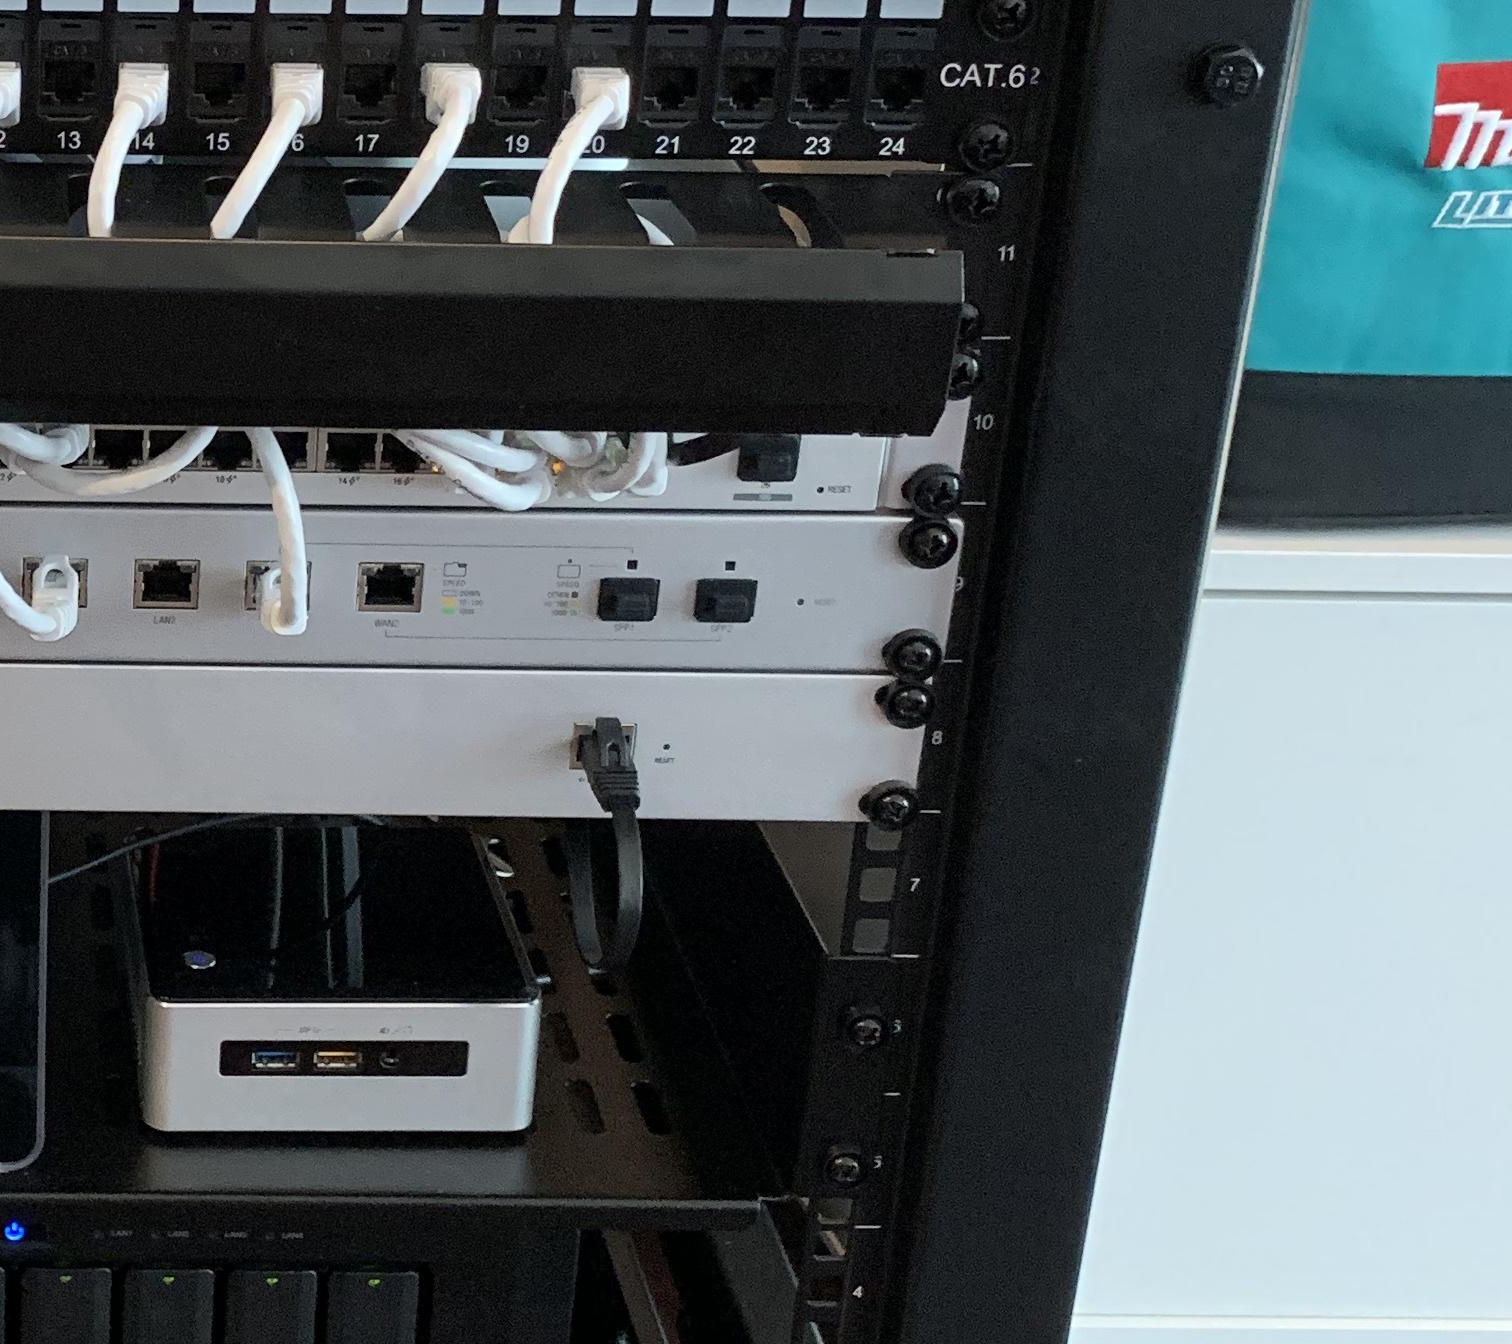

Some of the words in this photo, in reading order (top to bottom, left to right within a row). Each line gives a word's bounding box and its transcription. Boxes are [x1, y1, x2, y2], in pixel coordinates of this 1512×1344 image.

[940, 62, 1027, 90] CAT.6
[57, 130, 81, 149] 13
[206, 132, 230, 151] 15
[292, 132, 305, 153] 6
[355, 133, 380, 152] 17
[505, 134, 530, 154] 19
[654, 135, 680, 154] 21
[728, 135, 756, 155] 22
[803, 136, 831, 156] 23
[878, 136, 905, 156] 24
[998, 245, 1015, 262] 11
[973, 413, 994, 430] 10
[828, 485, 852, 494] RESET
[931, 730, 943, 745] 8
[910, 877, 921, 892] 7
[852, 1285, 863, 1298] 4
